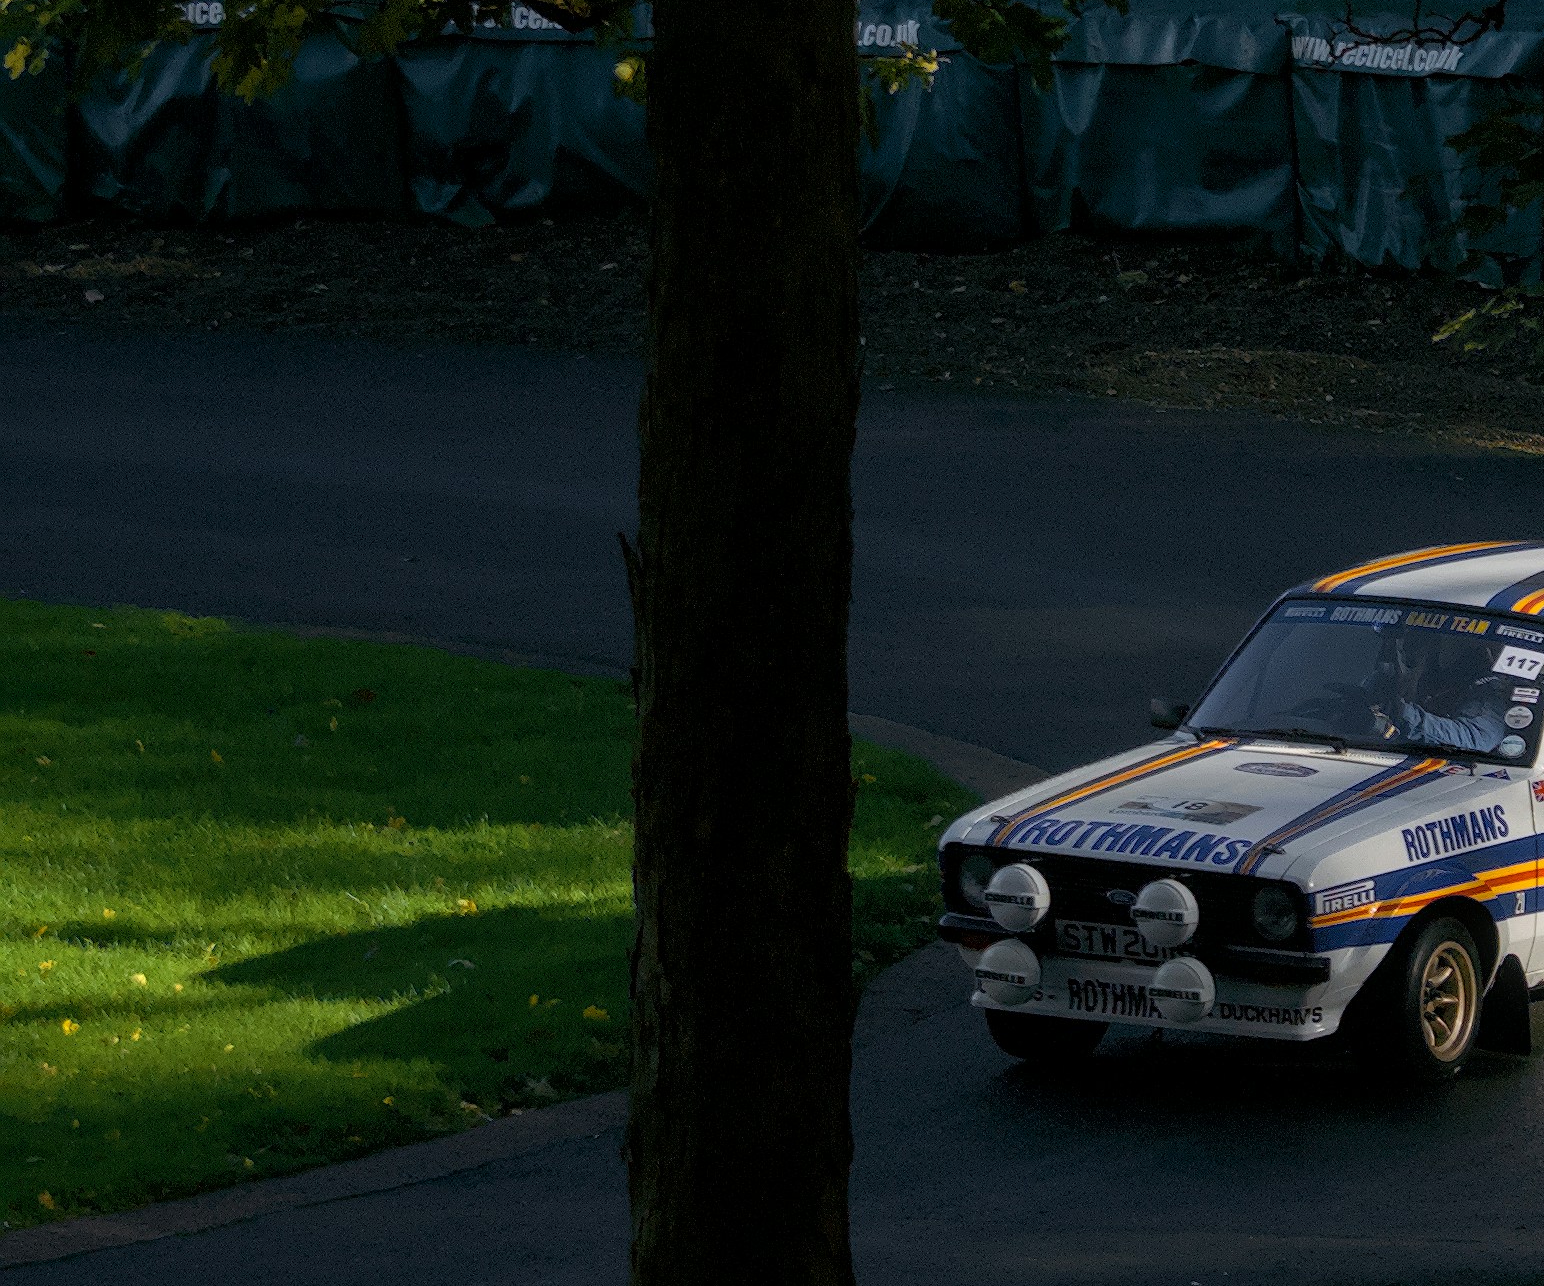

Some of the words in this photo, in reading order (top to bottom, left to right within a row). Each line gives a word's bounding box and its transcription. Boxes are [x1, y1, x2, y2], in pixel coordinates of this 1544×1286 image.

[1291, 35, 1464, 72] www.recticel.couk
[1329, 606, 1403, 625] ROTHMANS
[1405, 611, 1450, 630] RALLY
[1450, 616, 1492, 636] TEAM
[1505, 655, 1541, 672] 117
[1171, 800, 1209, 811] 18
[1018, 818, 1254, 866] ROTHMANS
[1401, 804, 1510, 863] ROTHMANS
[1315, 880, 1376, 916] PIRELLI
[1063, 923, 1117, 954] STW
[1067, 978, 1170, 1021] ROTHMA
